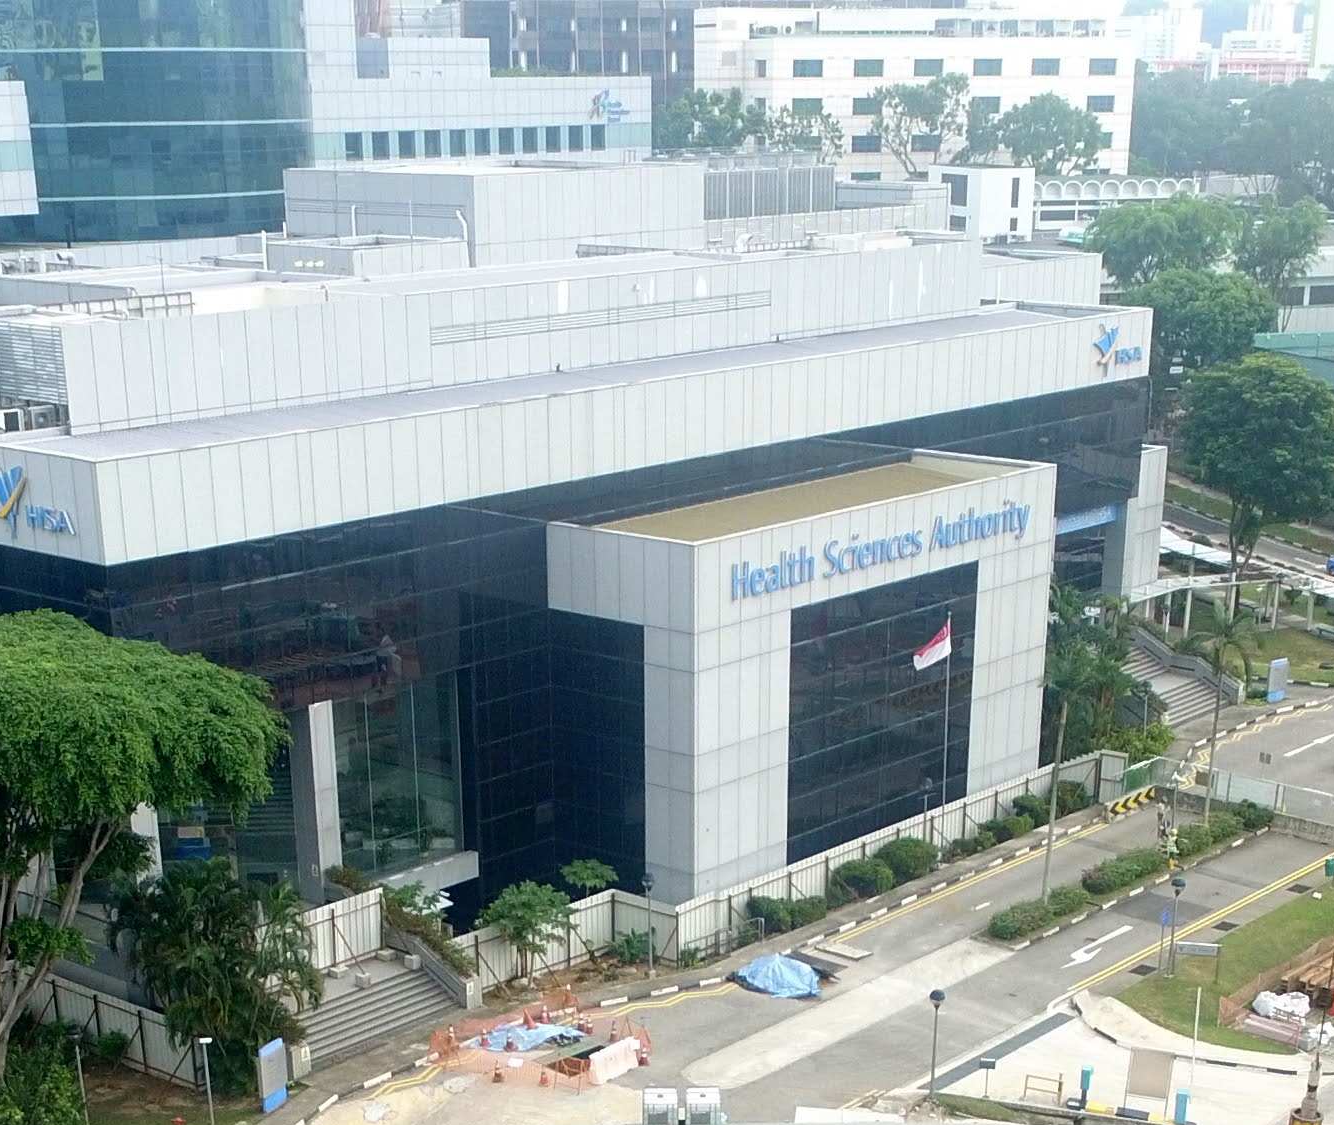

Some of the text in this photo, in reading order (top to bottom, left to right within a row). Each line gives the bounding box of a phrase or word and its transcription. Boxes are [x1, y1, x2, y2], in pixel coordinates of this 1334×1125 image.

[25, 504, 76, 535] HSA
[731, 544, 815, 600] Health
[824, 529, 924, 578] Sciences
[931, 499, 1031, 550] Authority
